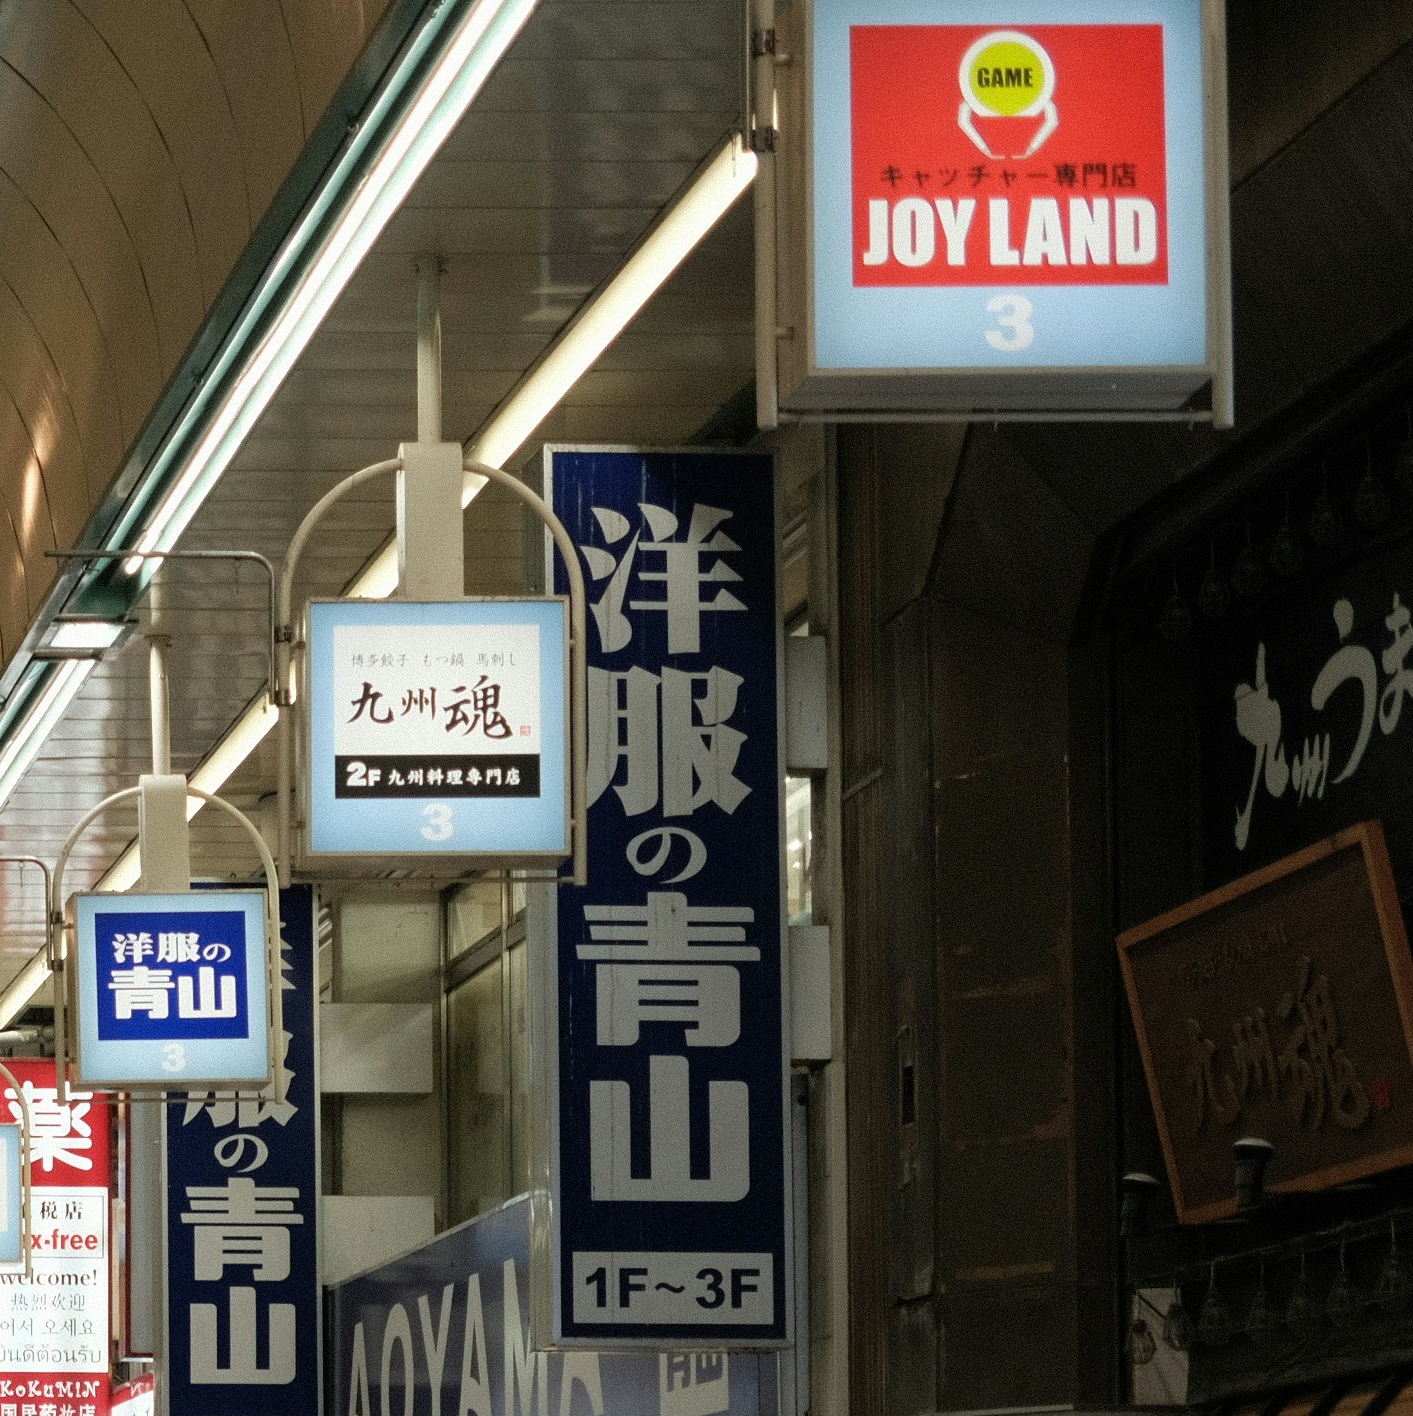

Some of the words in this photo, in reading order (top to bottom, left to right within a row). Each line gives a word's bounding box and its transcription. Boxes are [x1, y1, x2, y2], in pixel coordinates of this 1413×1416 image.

[977, 67, 1034, 88] GAME
[879, 163, 1138, 188] キャッチャー専門店
[863, 198, 976, 267] JOY
[989, 198, 1157, 266] LAND
[985, 294, 1034, 351] 3
[347, 675, 513, 739] 九州魂
[346, 761, 381, 787] 2F
[388, 768, 521, 786] 九州料理専門店
[422, 804, 453, 841] 3
[577, 502, 760, 1202] 洋服の青山
[111, 932, 231, 963] 洋服の
[108, 966, 237, 1020] 青山
[162, 1043, 186, 1072] 3
[4, 1081, 93, 1172] 薬
